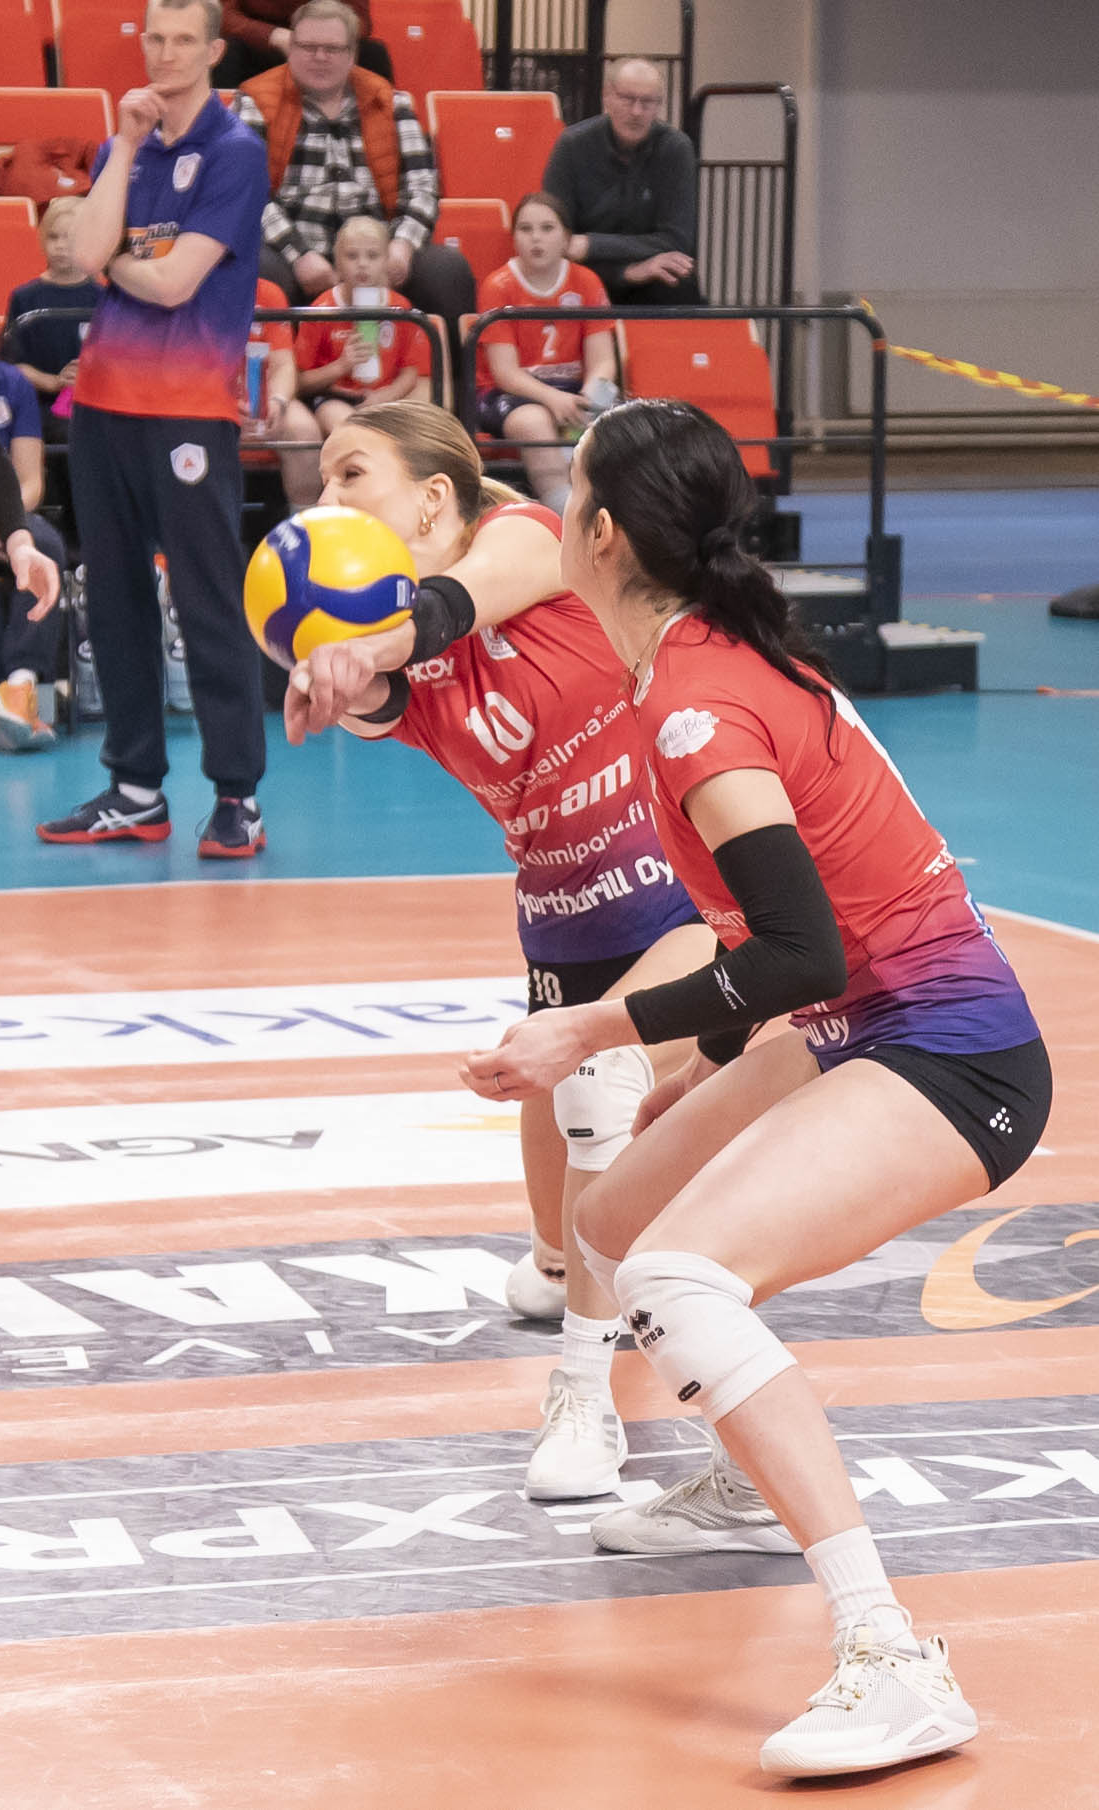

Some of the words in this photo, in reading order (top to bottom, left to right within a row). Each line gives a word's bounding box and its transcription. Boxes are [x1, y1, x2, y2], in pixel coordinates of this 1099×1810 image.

[465, 690, 535, 765] 10
[635, 855, 674, 886] Oy
[532, 968, 564, 1006] 10
